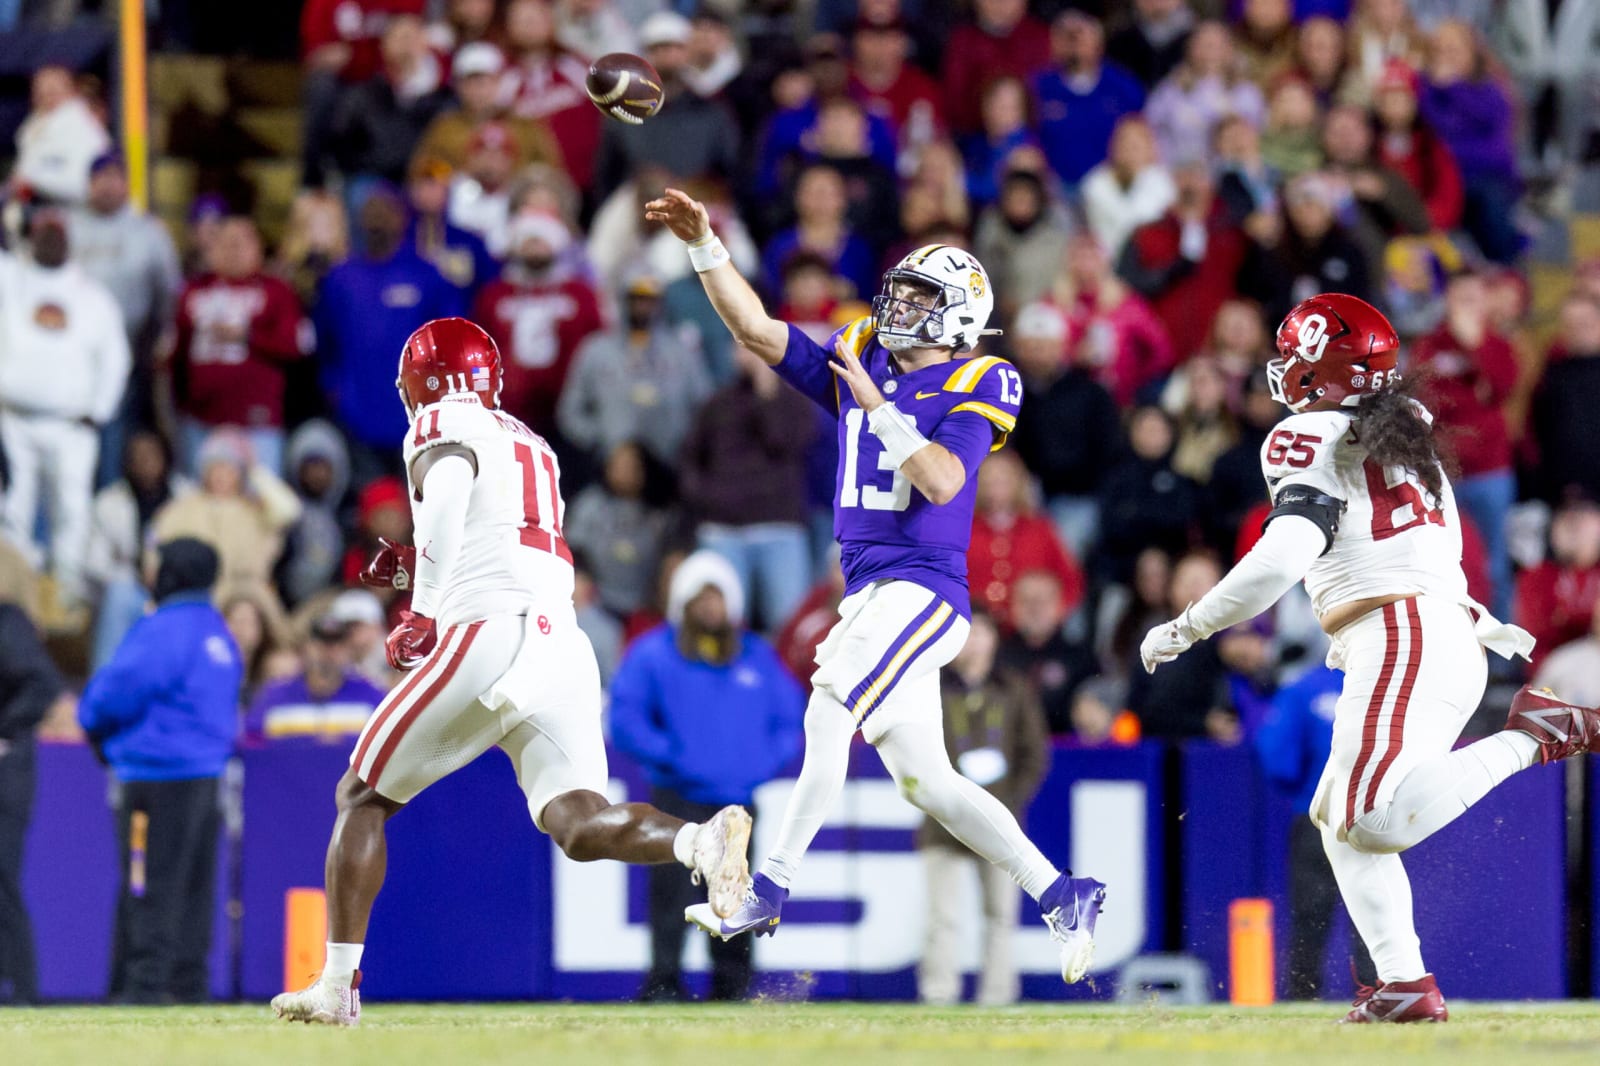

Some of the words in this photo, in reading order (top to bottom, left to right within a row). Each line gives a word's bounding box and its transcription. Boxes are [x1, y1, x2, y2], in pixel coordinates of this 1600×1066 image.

[1295, 313, 1329, 363] OU
[445, 372, 469, 394] 11
[998, 369, 1023, 406] 13
[413, 409, 441, 448] 11
[1266, 429, 1322, 469] 65
[840, 408, 917, 512] 13
[513, 440, 574, 568] 11
[1362, 454, 1446, 542] 6
[553, 778, 1146, 972] LSU
